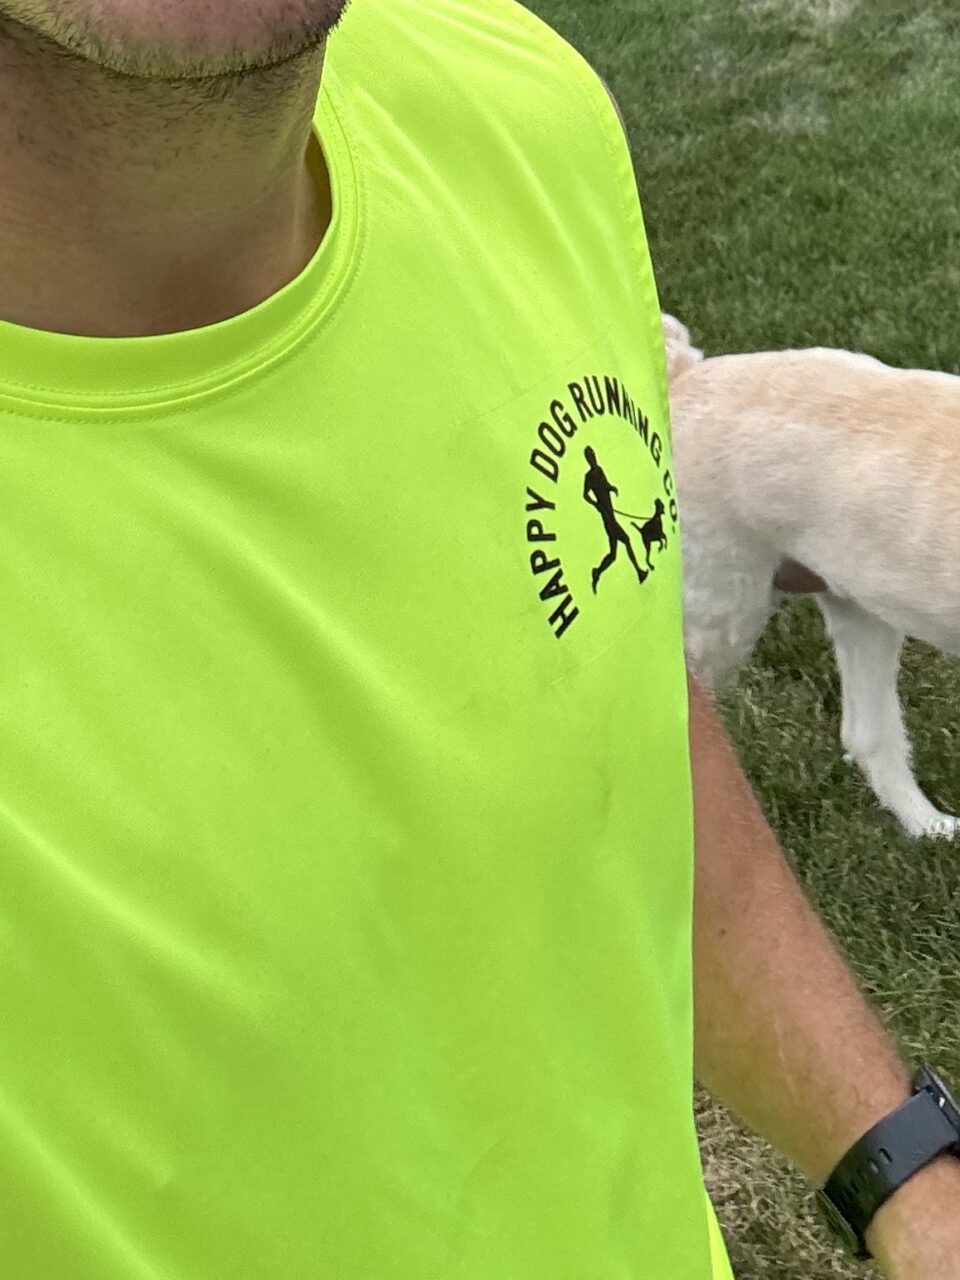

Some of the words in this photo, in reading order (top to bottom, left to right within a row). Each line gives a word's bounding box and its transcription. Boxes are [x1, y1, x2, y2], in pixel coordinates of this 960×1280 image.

[529, 399, 578, 483] DOG
[567, 375, 662, 468] RUNNING
[525, 486, 580, 639] HAPPY
